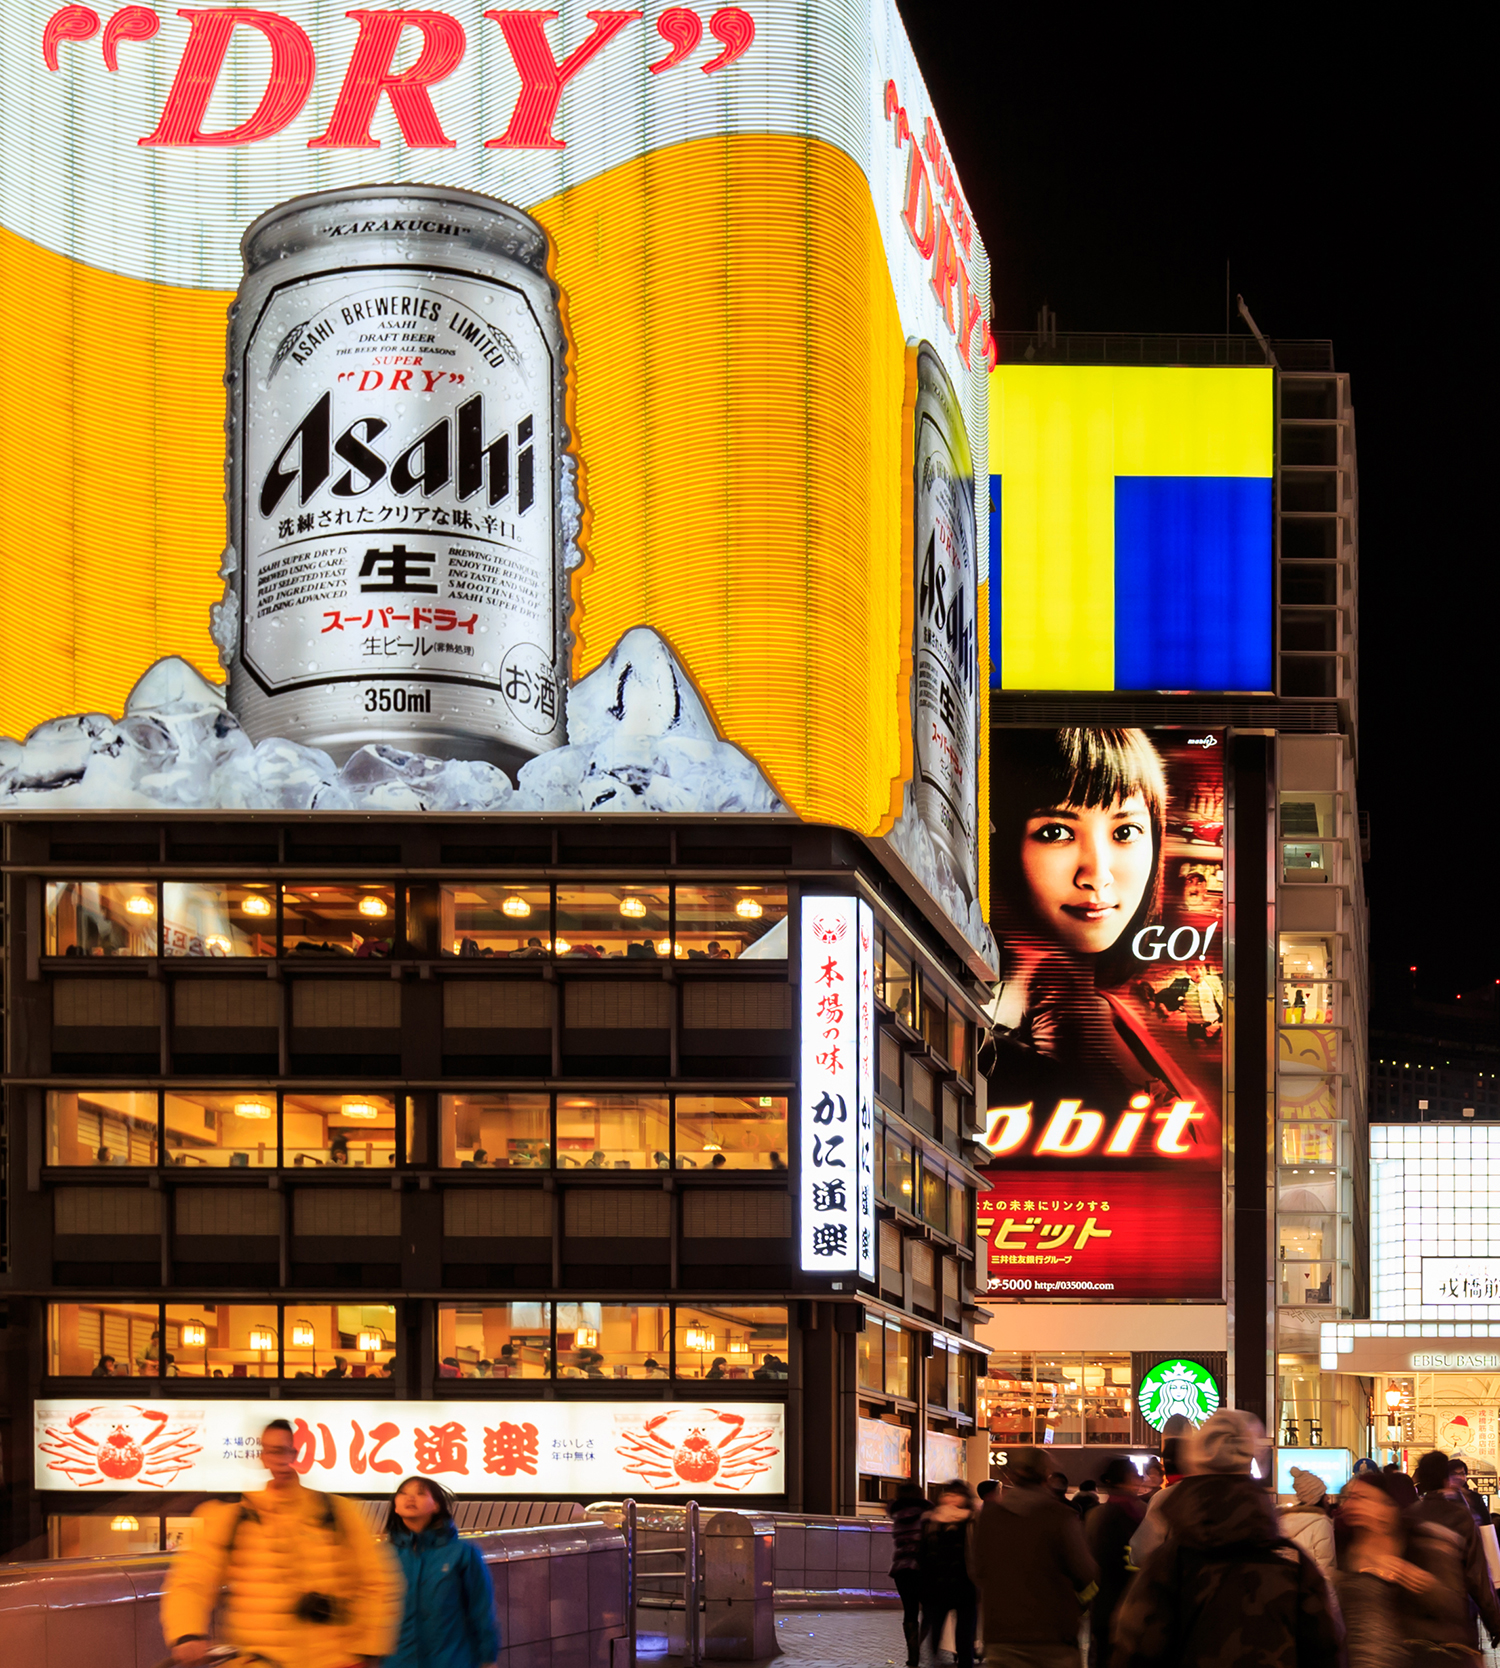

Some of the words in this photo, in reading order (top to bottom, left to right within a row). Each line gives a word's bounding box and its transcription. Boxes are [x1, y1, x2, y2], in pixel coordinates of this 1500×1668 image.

[291, 318, 336, 367] ASAHI
[341, 295, 442, 326] BREWERIES
[449, 312, 506, 369] LIMITED
[377, 320, 417, 330] ASAHI
[359, 333, 399, 344] DRAFT
[401, 333, 436, 344] BEER
[336, 348, 352, 356] THE
[354, 347, 379, 356] BEER
[380, 347, 398, 355] FOR
[399, 346, 417, 354] ALL
[419, 346, 456, 356] SEASONS
[371, 356, 423, 366] SUPER
[259, 389, 535, 519] Asahi
[258, 561, 280, 576] ASAHI
[281, 552, 311, 566] SUPER
[313, 549, 335, 558] DRY
[338, 546, 348, 554] IS
[448, 547, 492, 562] BREWING
[289, 562, 316, 574] USING
[358, 544, 439, 594] 生
[448, 558, 481, 570] ENJOY
[482, 562, 502, 574] THE
[278, 573, 318, 588] SELECTED
[319, 568, 347, 577] YEAST
[448, 569, 469, 578] ING
[470, 571, 498, 584] TASTE
[498, 579, 517, 590] AND
[257, 595, 274, 608] AND
[276, 579, 348, 600] INGREDIENTS
[295, 590, 348, 606] ADVANCED
[448, 580, 526, 603] SMOOTHNESS
[448, 591, 483, 603] ASAHI
[485, 597, 517, 611] SUPER
[321, 606, 479, 635] スーパードライ
[920, 527, 973, 697] Asahi
[365, 688, 431, 713] 350ml
[506, 665, 556, 720] お酒
[1132, 921, 1218, 962] GO!
[815, 955, 844, 1076] 本場の味
[977, 1200, 1111, 1211] たの未来にリンクする
[991, 1255, 1072, 1264] 三井住友銀行グループ
[1034, 1280, 1114, 1291] http://035000.com
[1413, 1354, 1452, 1368] EBISU
[551, 1451, 596, 1461] 年中無休
